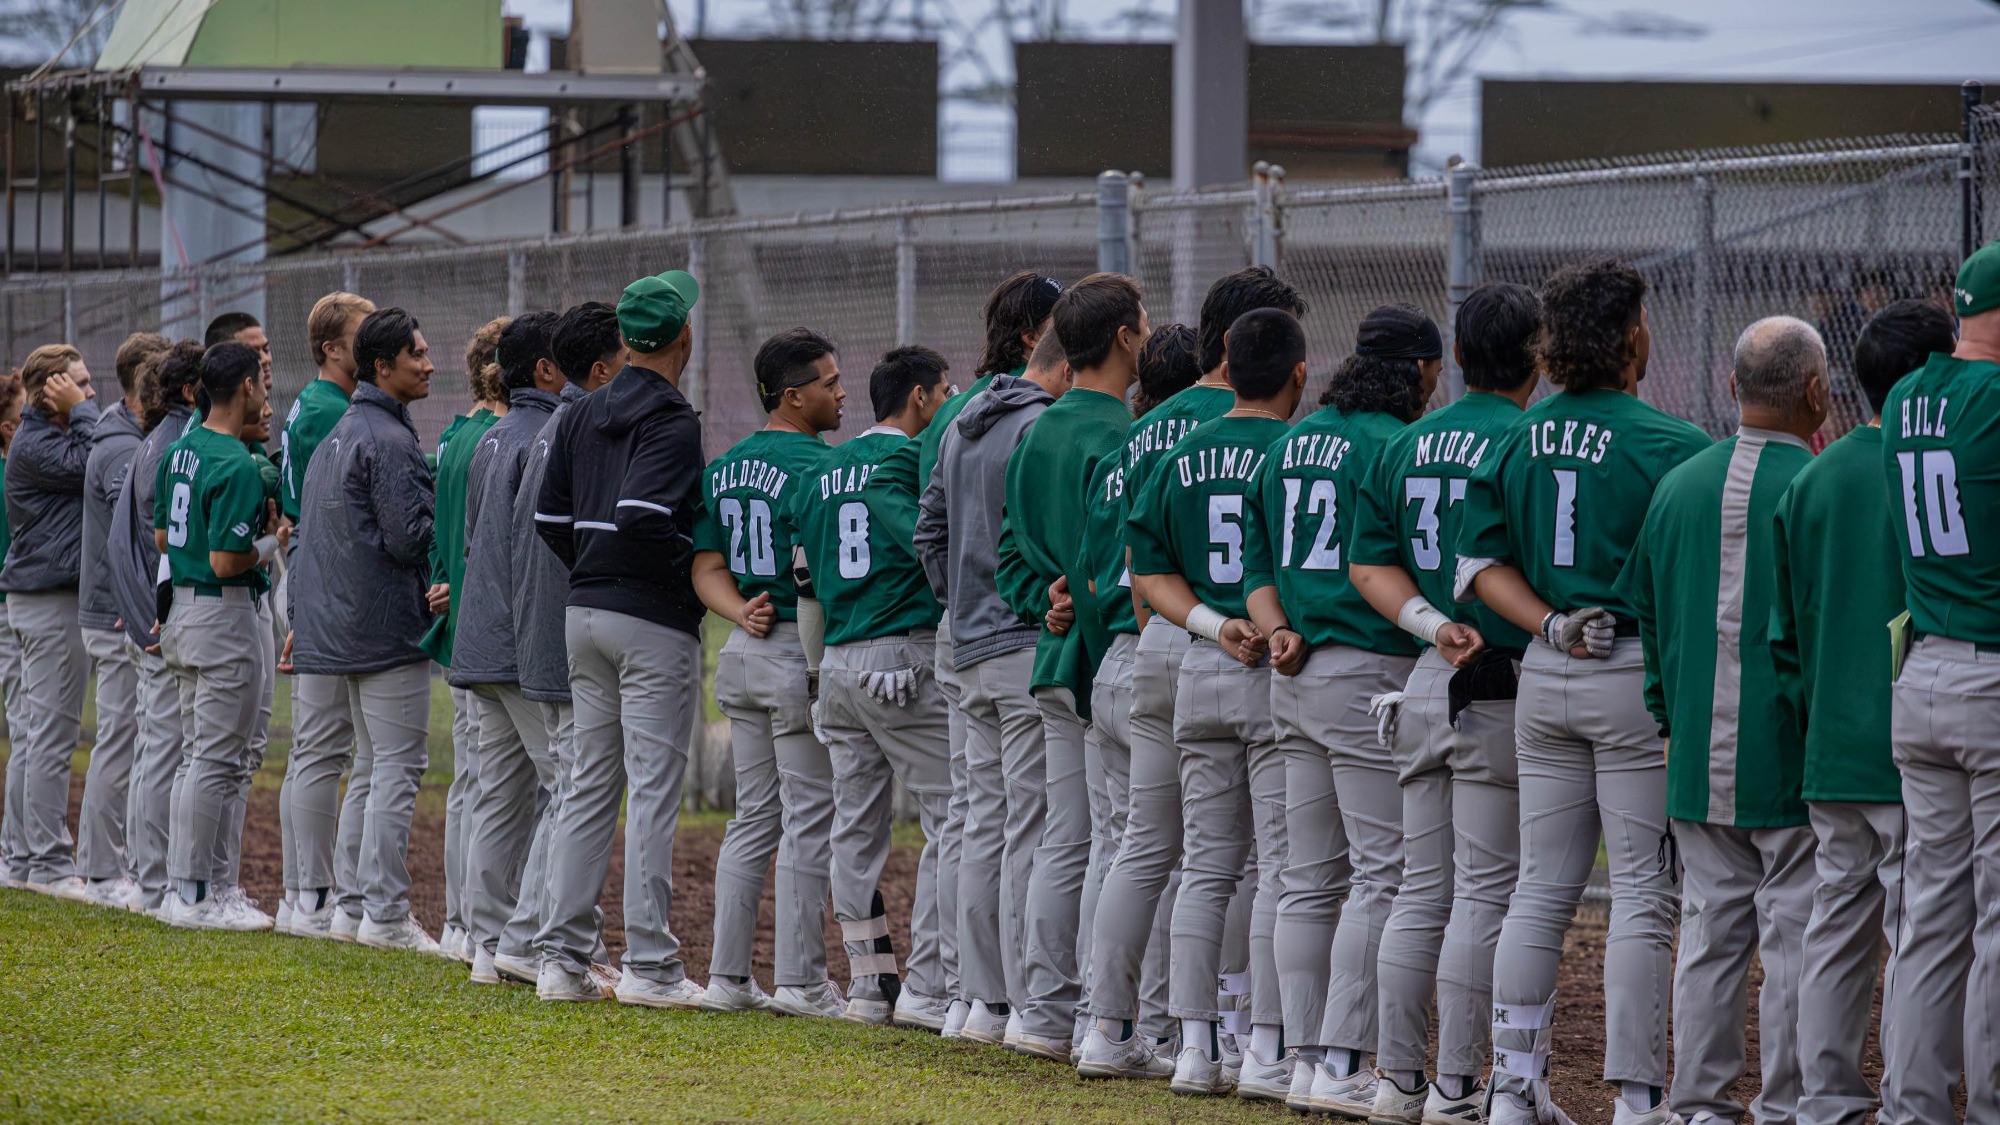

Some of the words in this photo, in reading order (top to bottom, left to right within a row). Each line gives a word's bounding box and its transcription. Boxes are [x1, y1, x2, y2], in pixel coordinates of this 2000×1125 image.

[1415, 430, 1490, 470] MIURA
[1530, 419, 1612, 464] ICKES
[1901, 395, 1948, 439] HILL
[712, 459, 789, 500] CALDERON
[820, 464, 880, 501] DUAR
[1282, 434, 1351, 472] ATKINS
[167, 481, 191, 548] 9
[719, 497, 777, 576] 20
[1281, 478, 1340, 570] 12
[1552, 469, 1577, 566] 1
[1896, 449, 1970, 558] 10
[838, 501, 871, 579] 8
[1208, 494, 1244, 584] 5
